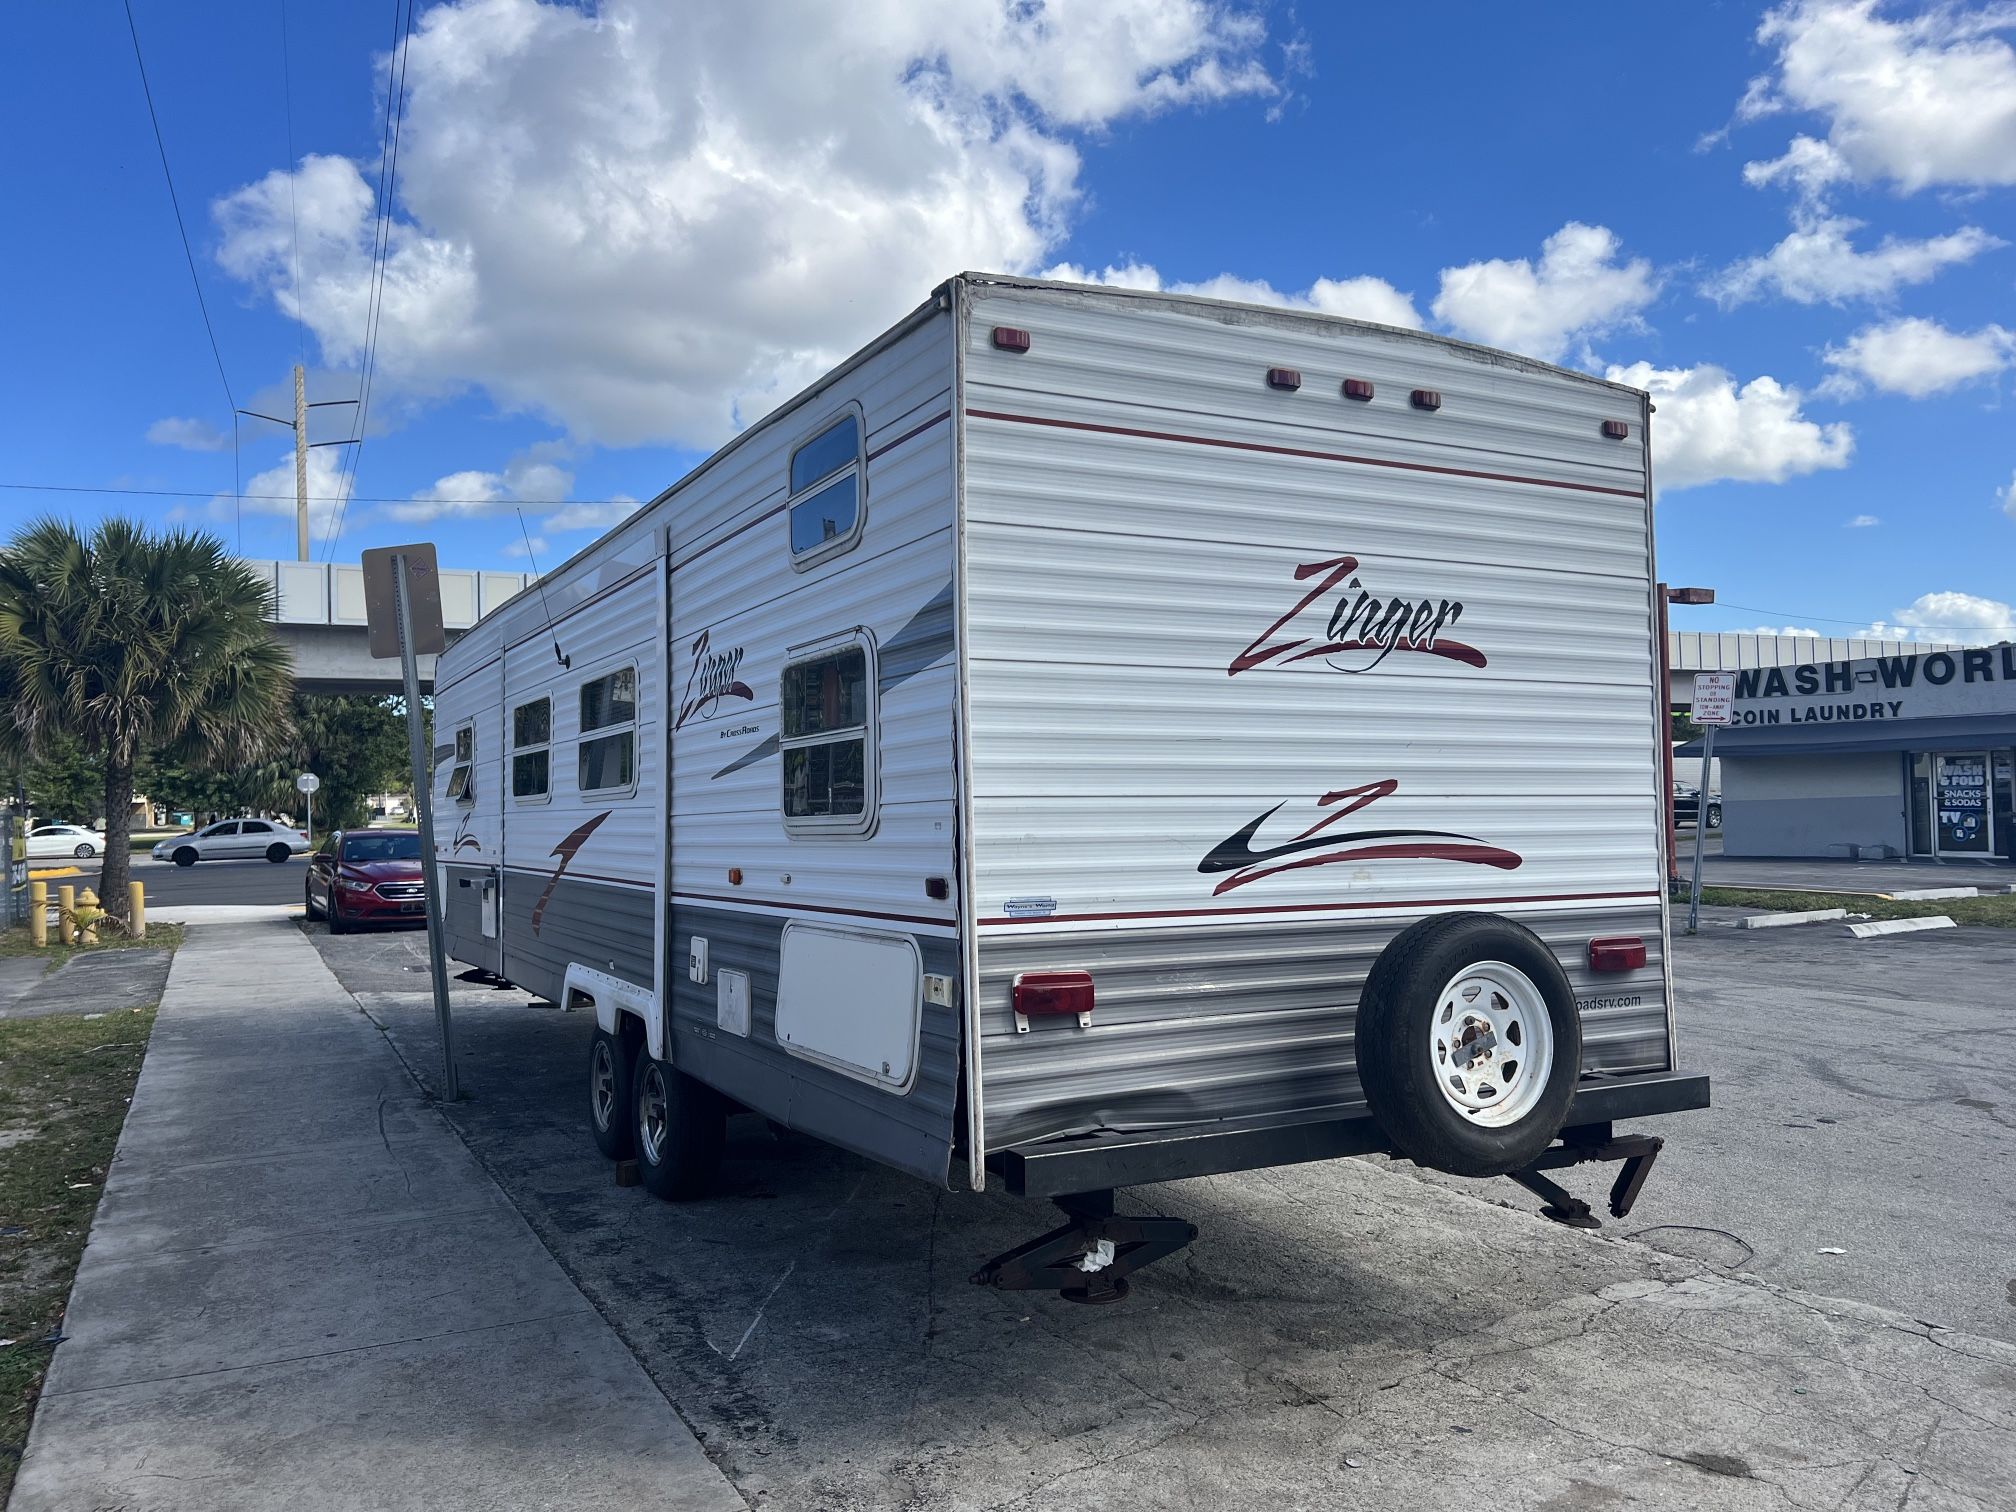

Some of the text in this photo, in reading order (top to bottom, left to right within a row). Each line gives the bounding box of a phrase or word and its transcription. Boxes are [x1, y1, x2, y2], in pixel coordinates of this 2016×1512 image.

[1228, 556, 1488, 676] Zinger
[1735, 661, 1852, 699] WASH
[1732, 701, 1904, 726] COIN LAUNDRY
[1942, 765, 1983, 776] WASH
[1952, 776, 1984, 785] FOLD
[1940, 812, 1961, 823] TV
